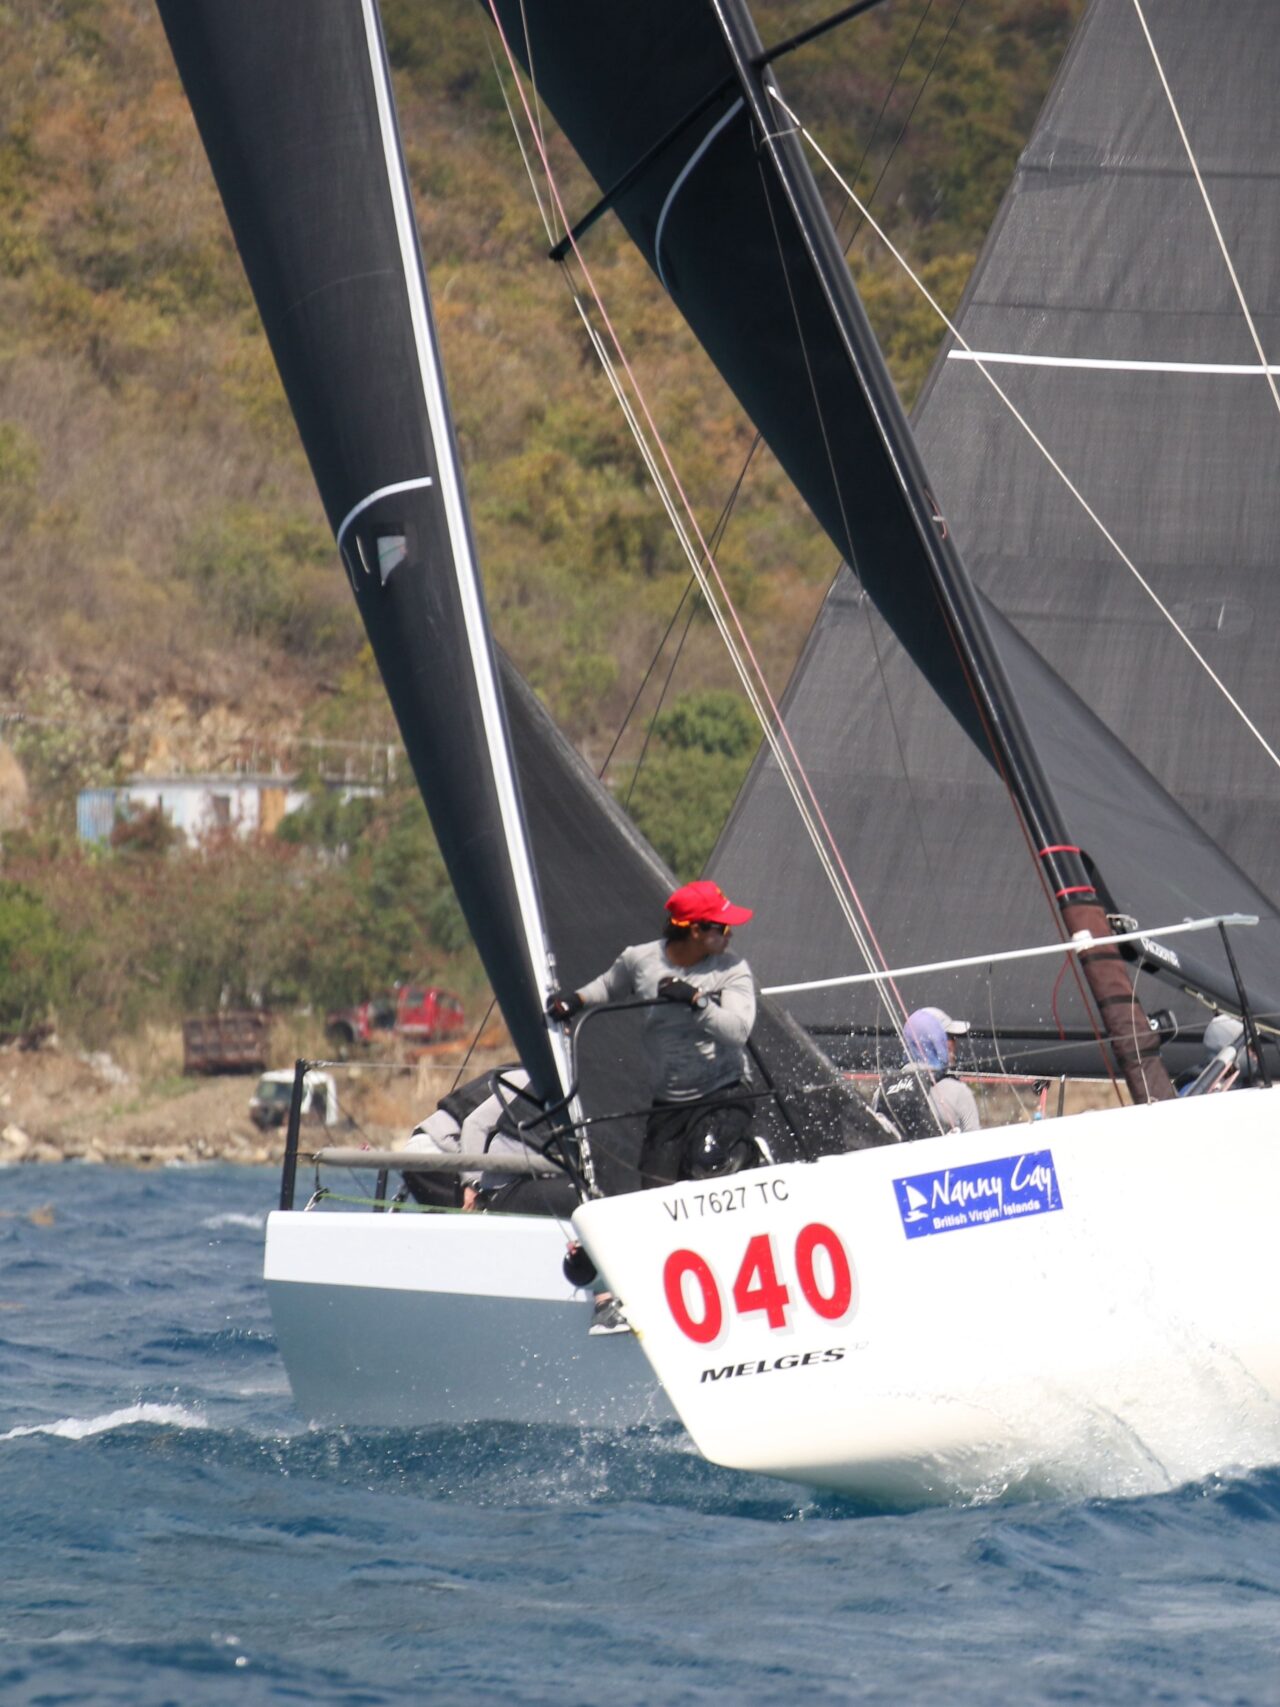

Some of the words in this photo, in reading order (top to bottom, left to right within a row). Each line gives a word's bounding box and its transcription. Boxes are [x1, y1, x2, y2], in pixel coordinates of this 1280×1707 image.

[663, 1198, 688, 1221] VI
[693, 1186, 746, 1216] 7627
[754, 1179, 789, 1204] TC
[931, 1171, 1003, 1214] Nanny
[1010, 1155, 1051, 1208] Cay
[932, 1212, 967, 1230] British
[968, 1206, 999, 1223] Virgin
[1003, 1199, 1041, 1216] Islands
[663, 1222, 852, 1343] 040
[700, 1347, 846, 1383] MELGES
